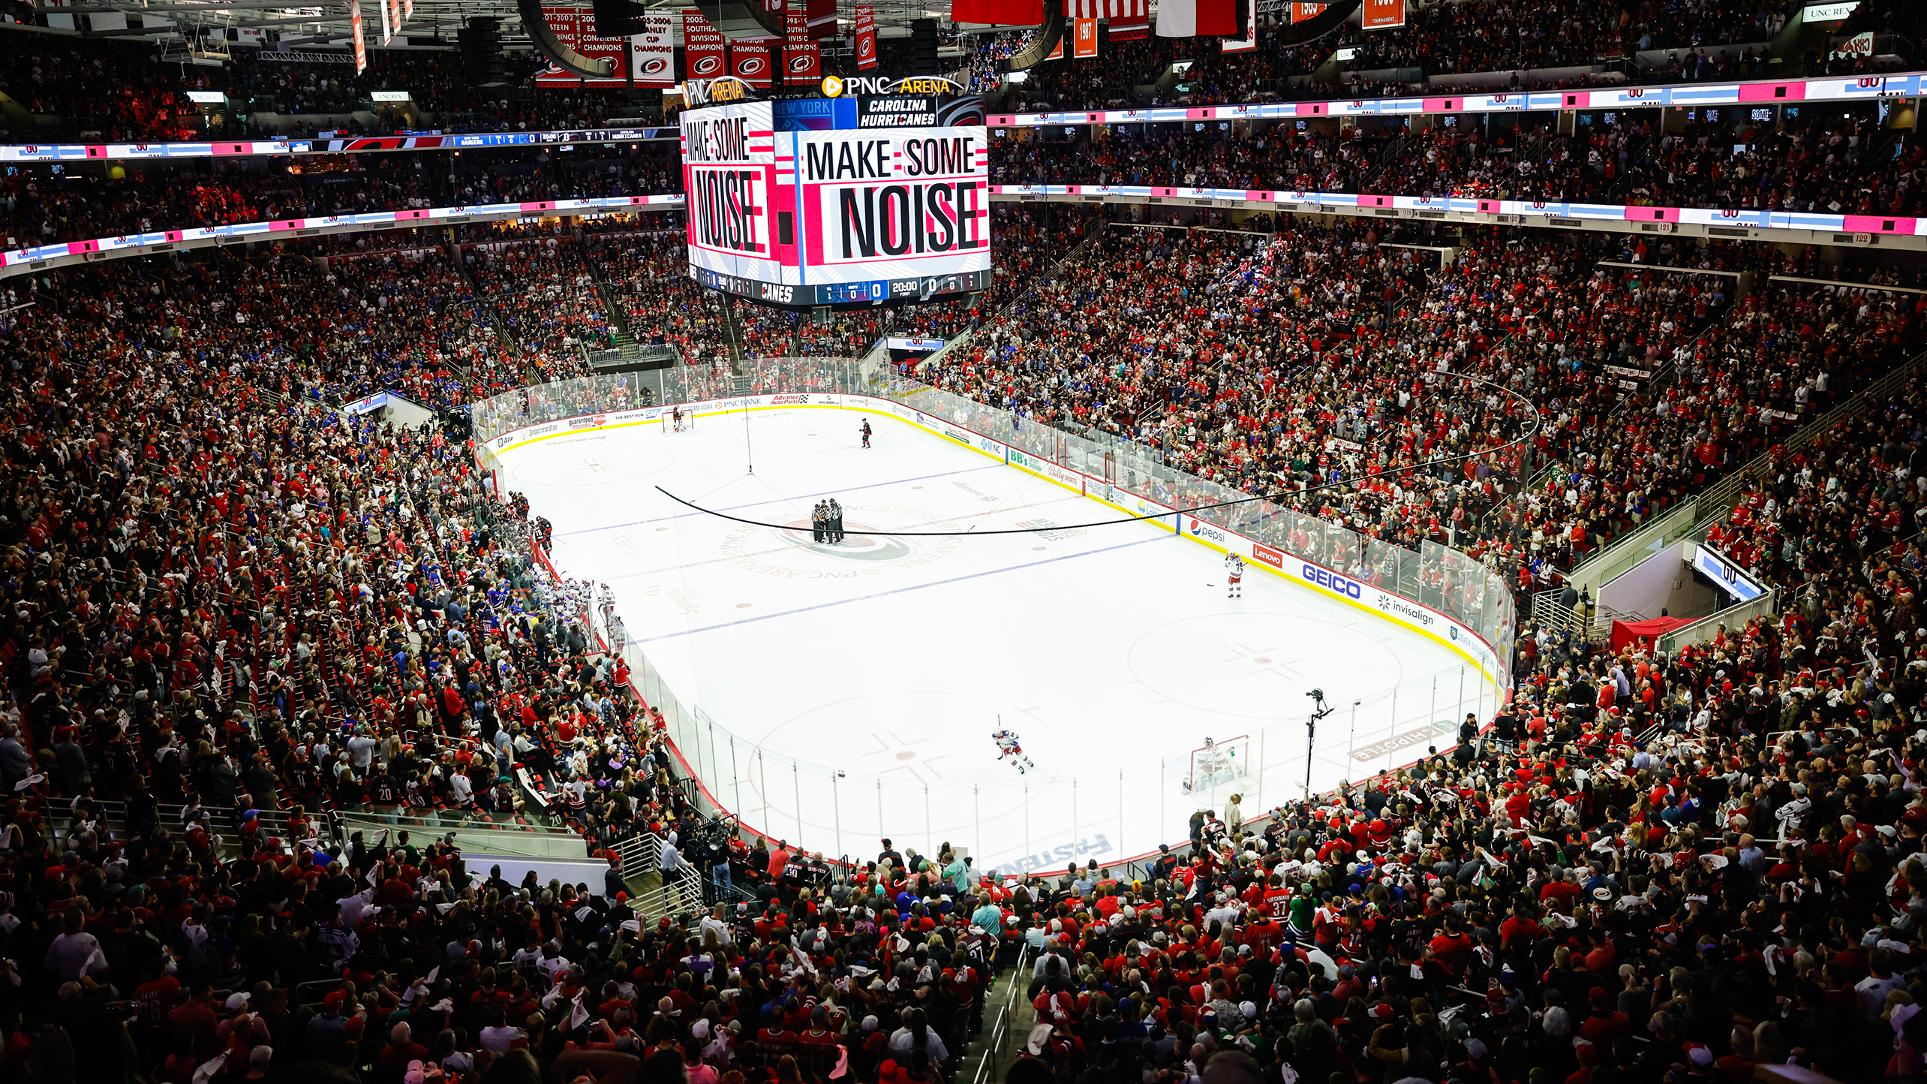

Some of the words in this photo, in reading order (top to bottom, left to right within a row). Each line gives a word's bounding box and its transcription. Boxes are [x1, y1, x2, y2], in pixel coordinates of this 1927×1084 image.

[1811, 9, 1831, 18] UNC
[634, 45, 672, 53] CHAMPIONS
[732, 45, 769, 53] CHAMPIONS
[688, 79, 709, 106] PNC
[711, 80, 745, 103] ARENA
[847, 77, 890, 95] PNC
[900, 77, 951, 94] ARENA
[801, 101, 830, 114] YORK
[869, 99, 927, 112] CAROLINA
[860, 113, 936, 127] HURRICANES
[685, 120, 711, 162] MAKE
[713, 117, 750, 162] SOME
[806, 140, 891, 181] MAKE
[904, 137, 975, 176] SOME
[695, 170, 757, 253] NOISE
[838, 181, 980, 259] NOISE
[761, 282, 794, 303] CANES
[850, 289, 857, 299] 0
[872, 284, 881, 298] 0
[892, 280, 918, 293] 20:00
[928, 278, 937, 292] 0
[723, 400, 743, 408] PNC
[744, 398, 762, 406] BANK
[1010, 449, 1029, 466] BB's
[1202, 526, 1225, 543] pepsi
[1254, 547, 1282, 565] Lenovo
[1302, 564, 1361, 600] GEICO
[1393, 600, 1434, 625] invisalign
[1353, 728, 1438, 760] CHIPOTLE
[379, 788, 392, 801] 20
[549, 814, 562, 827] 20
[1273, 901, 1287, 917] 37
